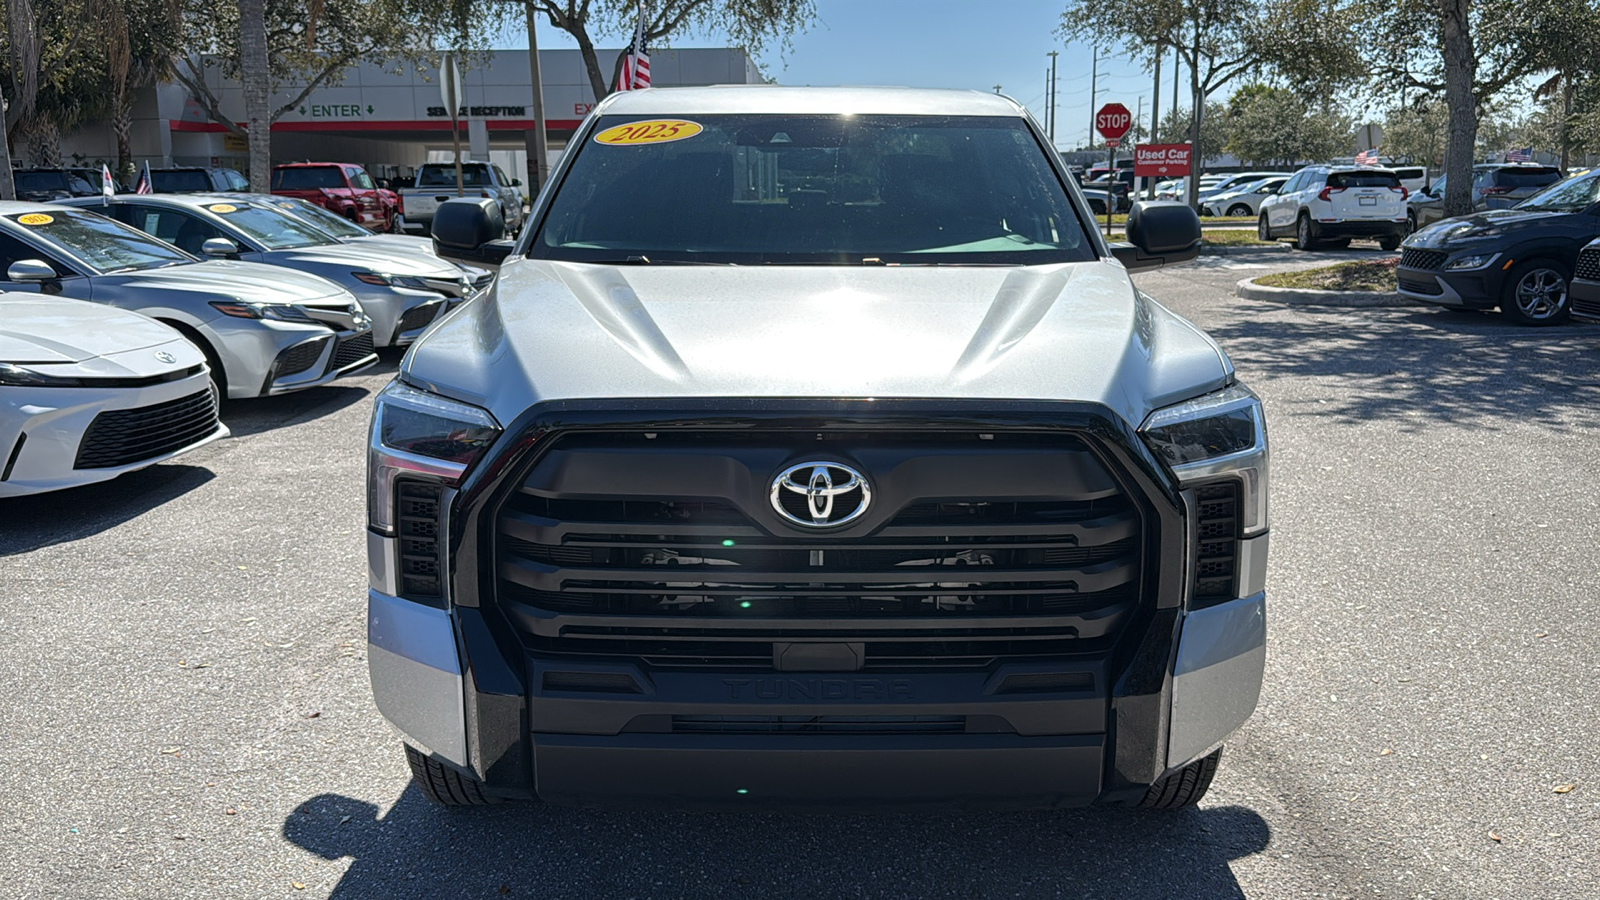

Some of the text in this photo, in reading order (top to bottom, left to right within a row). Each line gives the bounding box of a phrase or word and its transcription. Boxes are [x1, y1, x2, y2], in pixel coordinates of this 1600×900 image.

[312, 104, 361, 117] ENTER
[426, 106, 526, 117] SERCE RECEPTION
[1098, 114, 1128, 128] STOP
[609, 122, 687, 141] 2025
[1137, 149, 1189, 159] Used Car
[722, 678, 915, 700] TUNDRA
